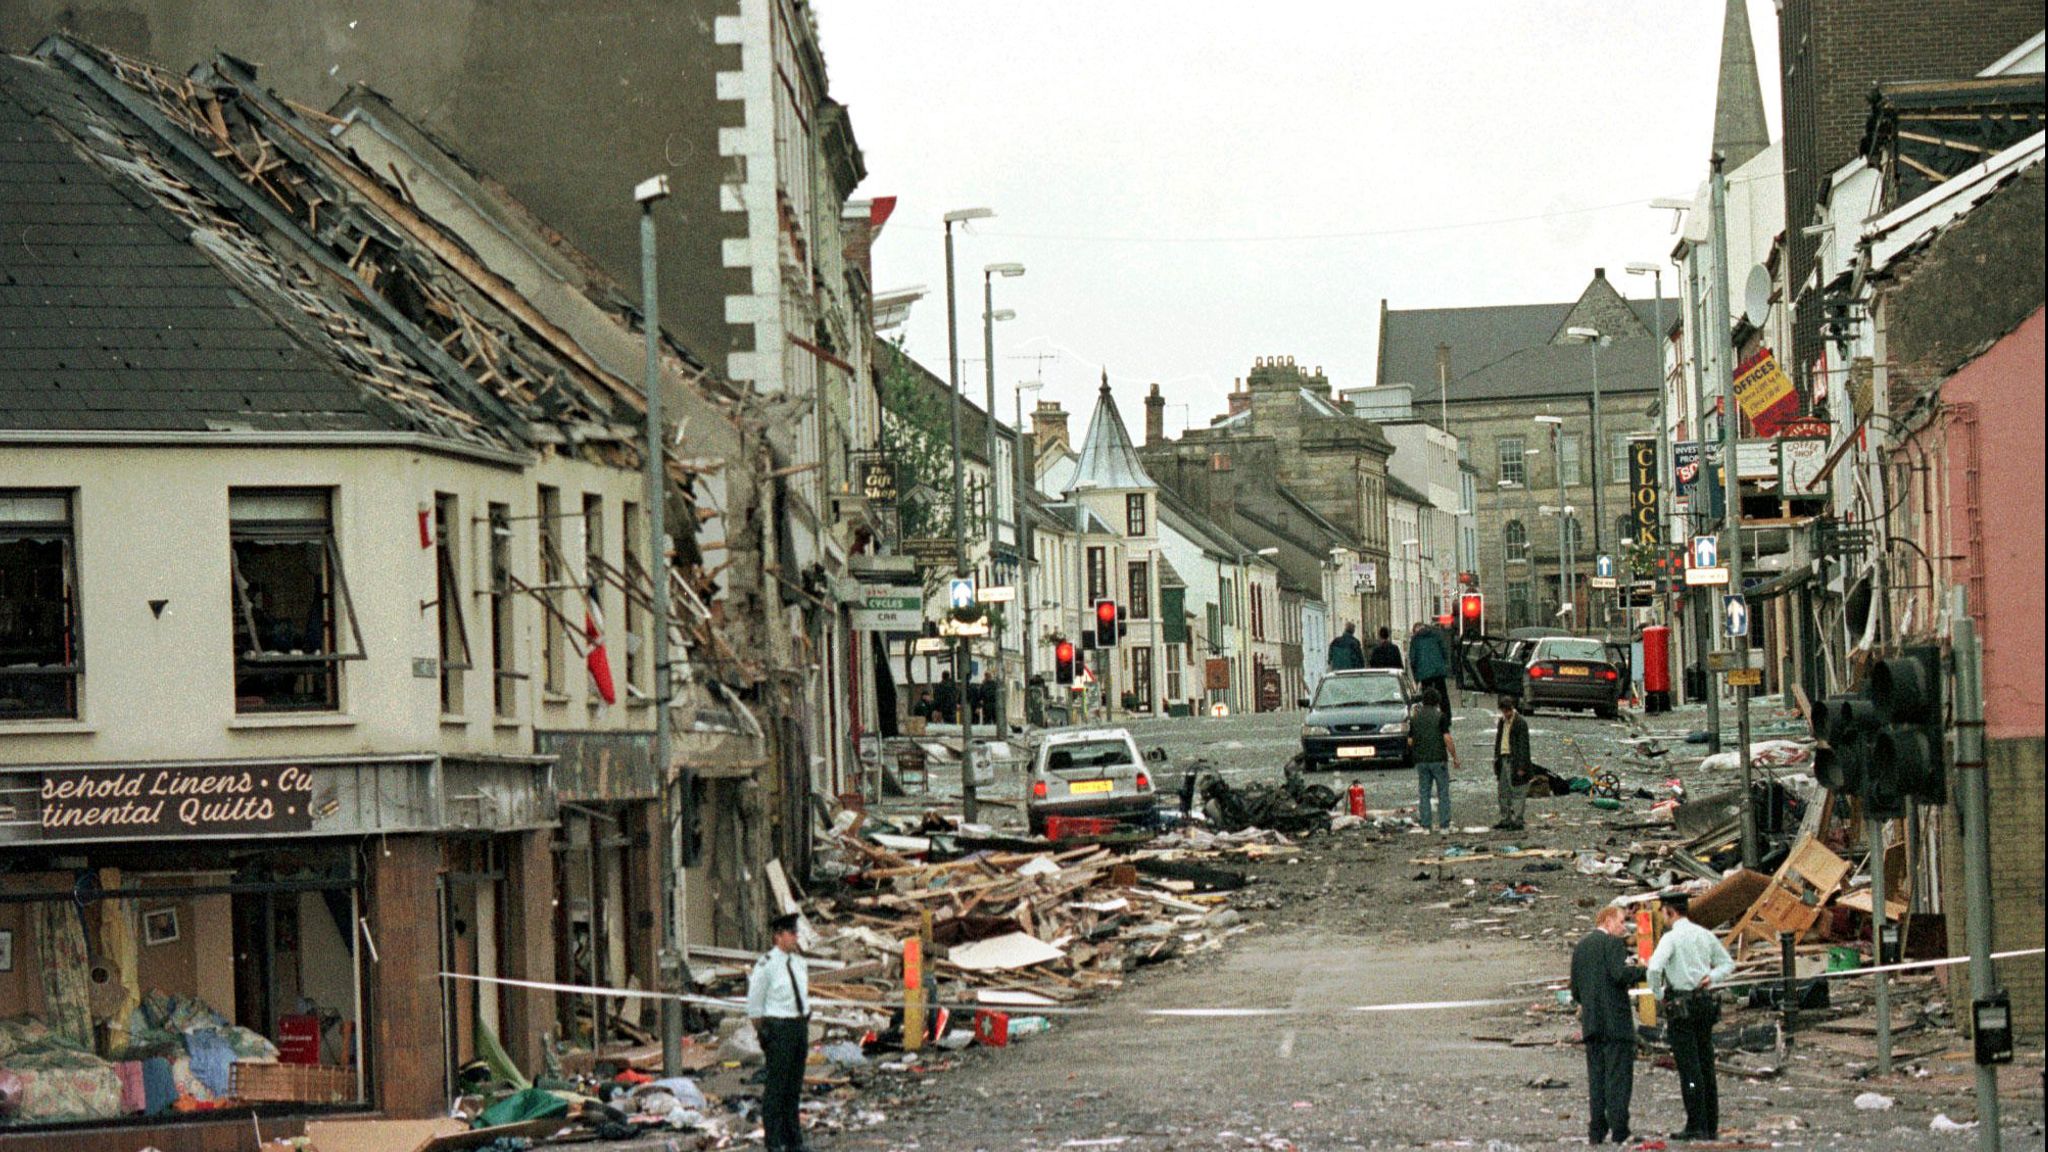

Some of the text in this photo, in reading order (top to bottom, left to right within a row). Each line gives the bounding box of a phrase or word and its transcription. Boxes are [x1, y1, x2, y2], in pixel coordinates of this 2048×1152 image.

[1733, 361, 1776, 395] OFFICES
[864, 486, 897, 499] Shop
[866, 474, 893, 488] Gift
[1637, 448, 1657, 546] CLOCK
[868, 599, 904, 609] CYCLES
[41, 772, 147, 800] sehold
[150, 770, 253, 796] Linens
[42, 797, 275, 827] tinental Quilts
